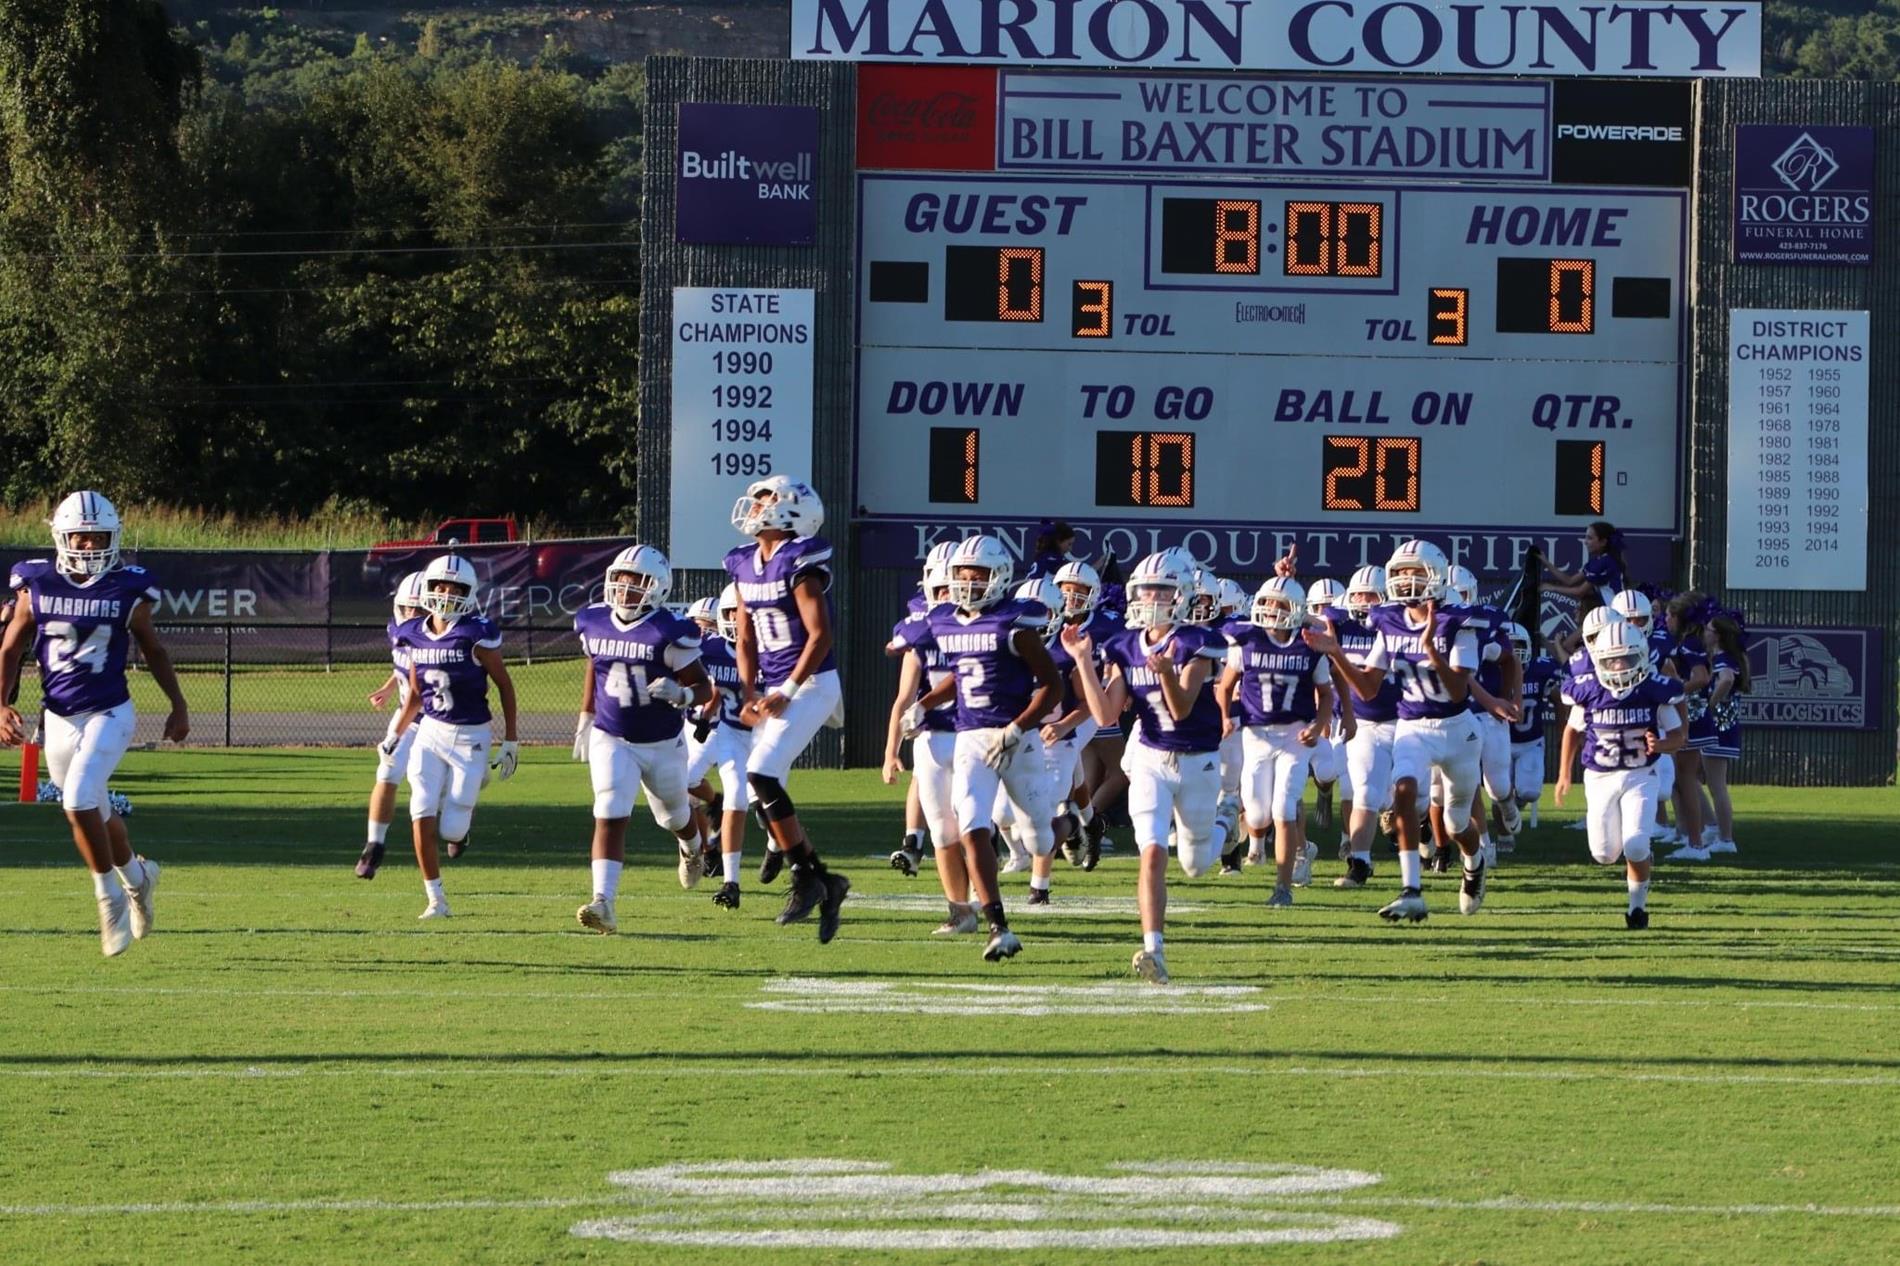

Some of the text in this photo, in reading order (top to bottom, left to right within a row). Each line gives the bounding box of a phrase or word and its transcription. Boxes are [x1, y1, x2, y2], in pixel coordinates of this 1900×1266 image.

[806, 0, 1744, 72] MARION COUNTY
[1139, 82, 1408, 118] WELCOME TO
[1012, 118, 1535, 169] BILL BAXTER STADIUM
[1557, 124, 1683, 141] POWERADE
[757, 184, 810, 200] BANK
[904, 192, 1087, 236] GUEST
[1740, 194, 1870, 224] ROGERS
[1465, 205, 1628, 247] HOME
[1746, 227, 1864, 240] FUNERAL HOME
[1215, 200, 1380, 277] 8:00
[1739, 252, 1870, 262] WWW.ROGERSFUNERALHOME.COM
[999, 248, 1041, 321] 0
[1550, 259, 1593, 333] 0
[711, 293, 780, 314] STATE
[1077, 282, 1110, 337] 3
[1123, 314, 1176, 337] TOL
[1433, 289, 1465, 344] 3
[679, 322, 808, 344] CHAMPIONS
[1365, 319, 1417, 342] TOL
[1752, 321, 1848, 338] DISTRICT
[712, 351, 773, 375] 1990
[1736, 344, 1863, 361] CHAMPIONS
[1759, 368, 1840, 381] 1952 1955
[712, 385, 773, 409] 1992
[886, 381, 1025, 416] DOWN
[1080, 385, 1214, 421] TO GO
[1759, 385, 1840, 398] 1957 1960
[1274, 389, 1473, 426] BALL ON
[1532, 394, 1633, 431] QTR.
[1759, 402, 1840, 415] 1961 1964
[711, 418, 773, 442] 1994
[1759, 419, 1840, 432] 1968 1978
[1759, 436, 1839, 449] 1980 1981
[711, 452, 772, 476] 1995
[964, 430, 976, 501] 1
[1131, 433, 1192, 506] 10
[1759, 453, 1839, 466] 1982 1984
[1325, 437, 1418, 510] 20
[1590, 443, 1602, 514] 1
[1758, 470, 1840, 483] 1985 1988
[1758, 487, 1840, 500] 1989 1990
[1758, 504, 1839, 517] 1991 1992
[1758, 521, 1838, 534] 1993 1994
[1758, 538, 1838, 551] 1995 2014
[1756, 555, 1789, 567] 2016
[40, 594, 121, 618] WARRIORS
[151, 588, 257, 616] WER
[44, 621, 113, 674] 24
[588, 637, 654, 661] WARRIORS
[937, 633, 998, 653] WARRIORS
[1251, 651, 1309, 671] WARRIORS
[424, 669, 454, 712] 3
[603, 661, 652, 708] 41
[957, 657, 991, 708] 2
[1258, 673, 1299, 713] 17
[1591, 703, 1651, 725] WARRIORS
[1772, 704, 1862, 722] LOGISTICS
